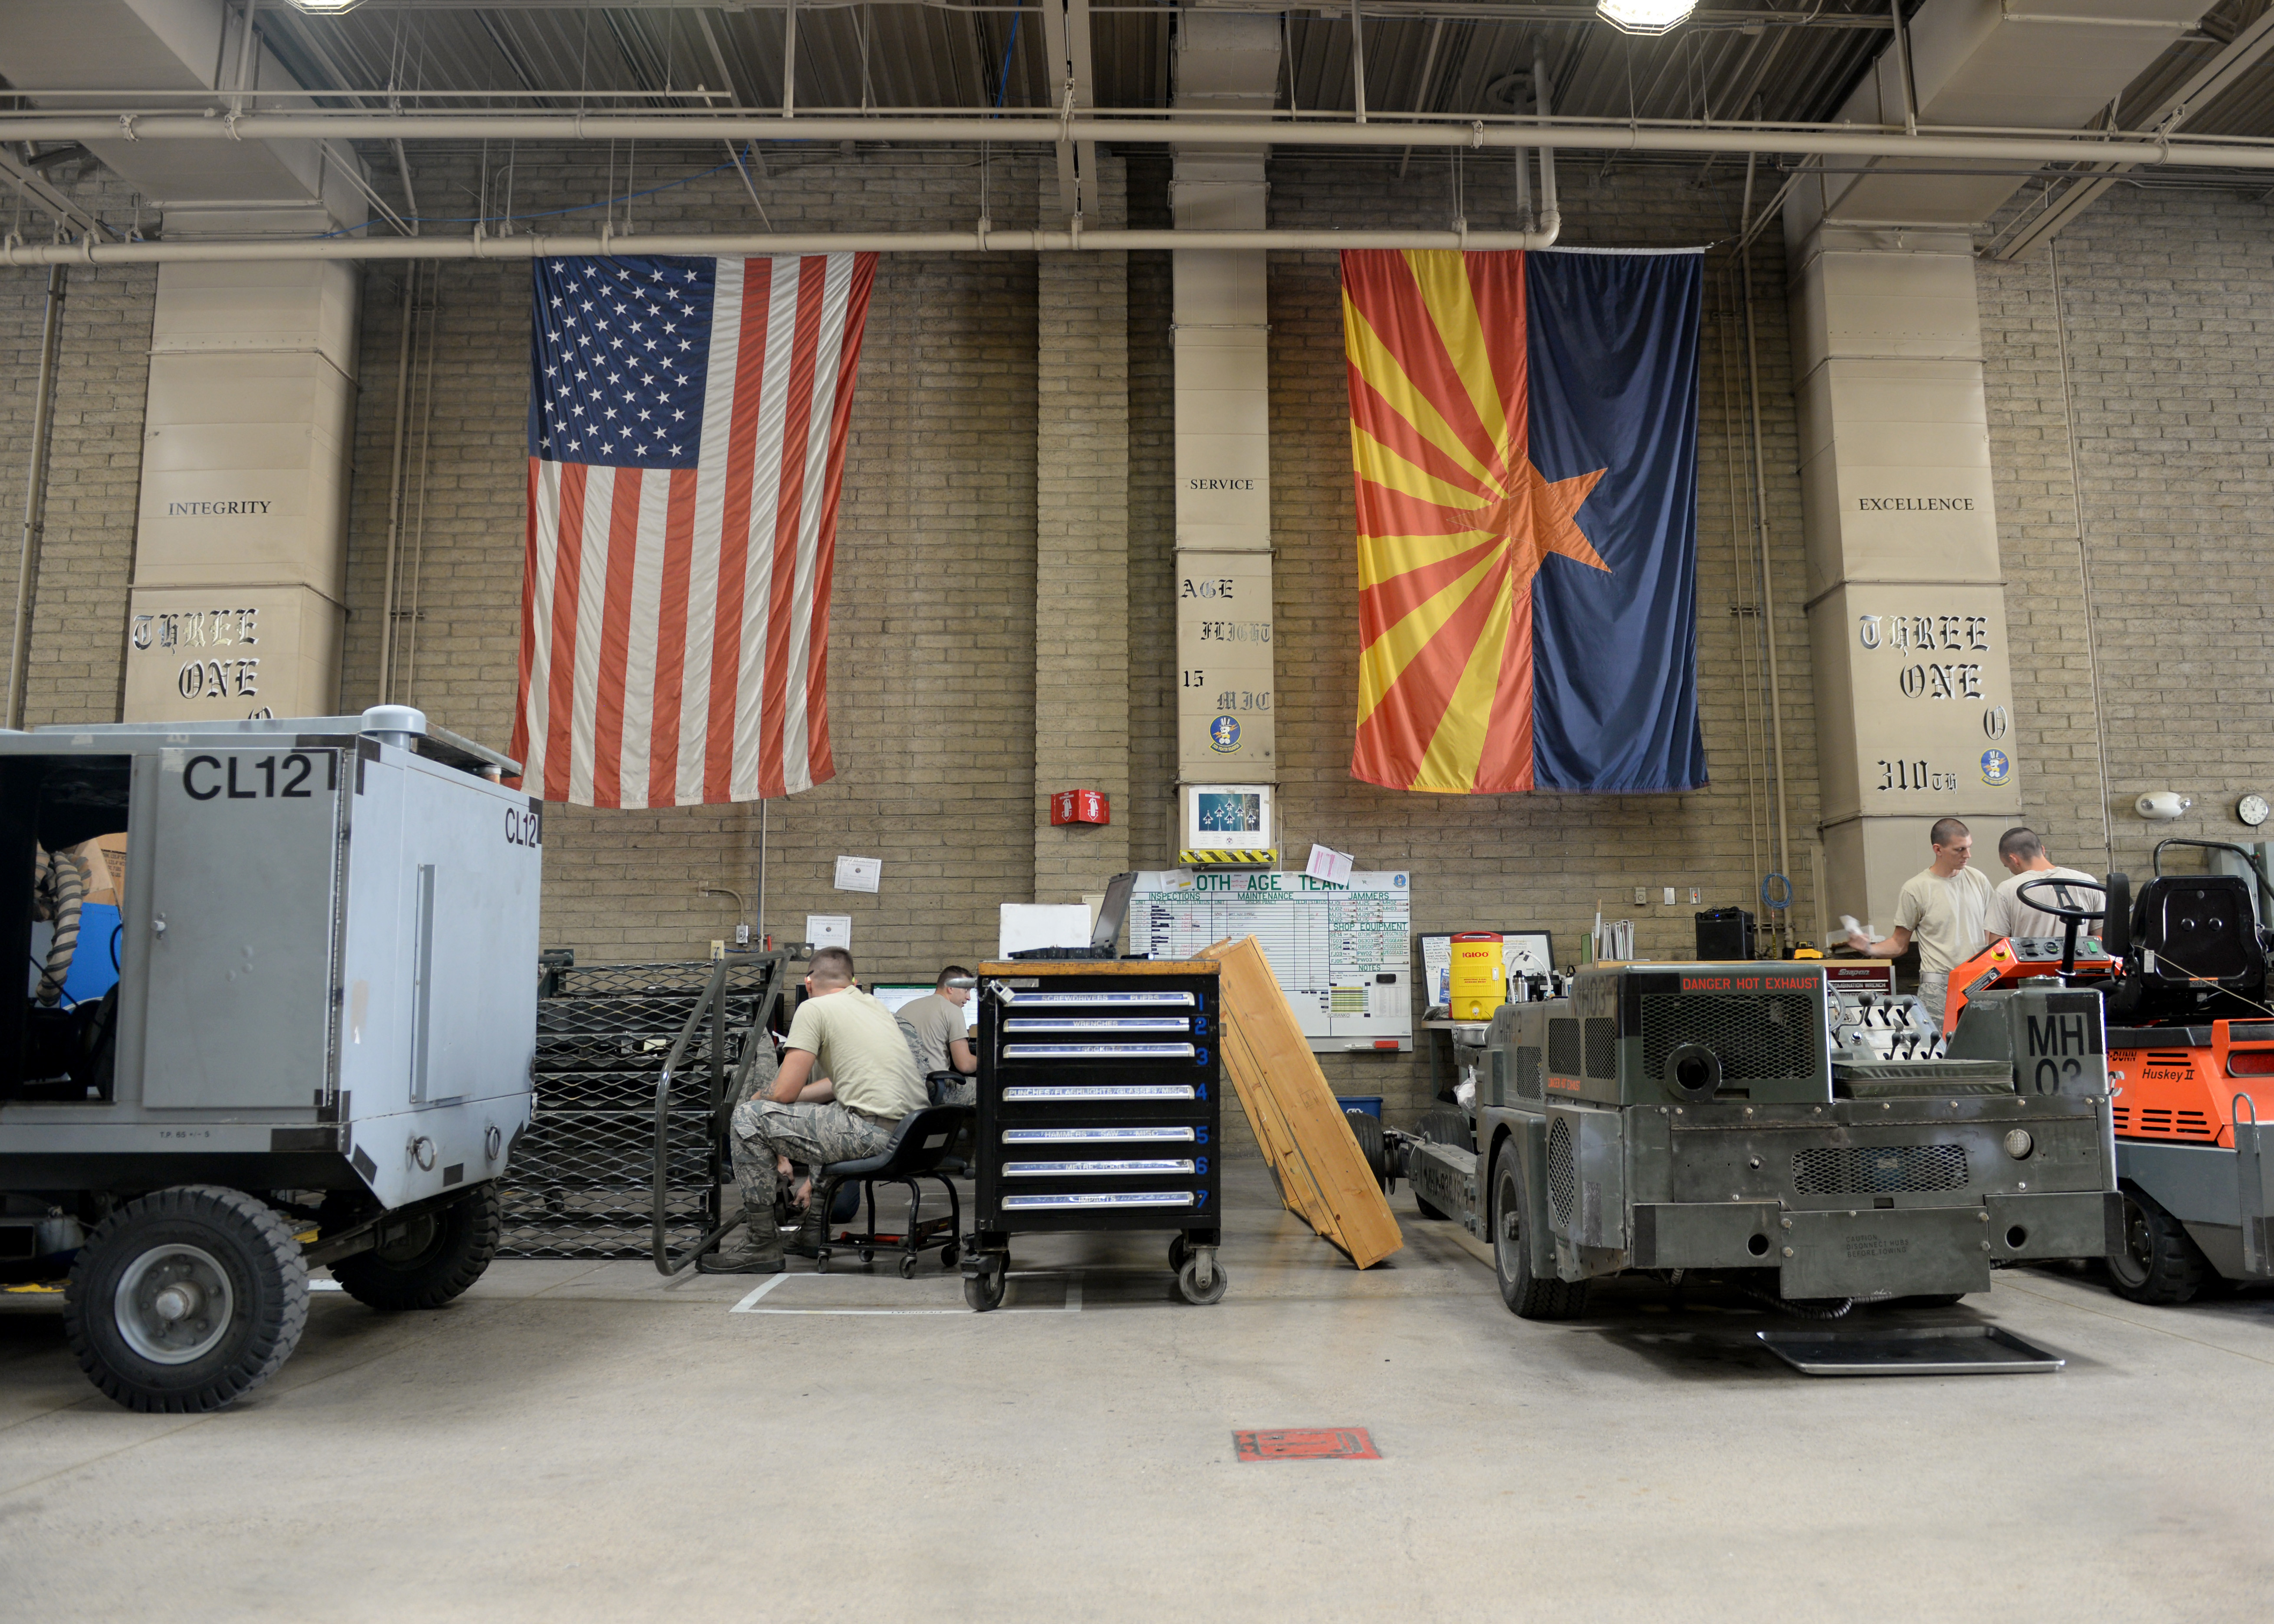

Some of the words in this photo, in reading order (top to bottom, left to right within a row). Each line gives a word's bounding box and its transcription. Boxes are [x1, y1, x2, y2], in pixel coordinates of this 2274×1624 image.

[1190, 479, 1254, 490] SERVICE
[168, 501, 272, 516] INTEGRITY
[1859, 498, 1975, 511] EXCELLENCE
[1180, 578, 1234, 599] AGE
[133, 608, 260, 655] THREE
[1860, 614, 1991, 657] THREE
[178, 657, 260, 699] ONE
[1183, 670, 1204, 688] 15
[1899, 663, 1986, 701] ONE
[182, 753, 312, 801] CL12
[505, 807, 536, 849] CL12
[1182, 875, 1230, 891] 0TH
[1247, 875, 1282, 891] AGE
[1683, 978, 1731, 991] DANGER
[1736, 978, 1759, 989] HOT
[1765, 977, 1818, 989] EXHAUST
[1199, 993, 1203, 1011] 1
[1195, 1017, 1207, 1035] 2
[2027, 1015, 2084, 1056] MH
[1196, 1047, 1208, 1065] 3
[2142, 1069, 2183, 1083] Huskey
[2184, 1070, 2195, 1080] II
[1195, 1083, 1207, 1100] 4
[1196, 1126, 1209, 1144] 5
[1195, 1156, 1208, 1175] 6
[1196, 1190, 1208, 1208] 7
[1846, 1234, 1877, 1243] CAUTION
[1846, 1241, 1887, 1250] DISONNECT
[1847, 1249, 1876, 1258] BEFORE
[1879, 1247, 1906, 1255] TOWING
